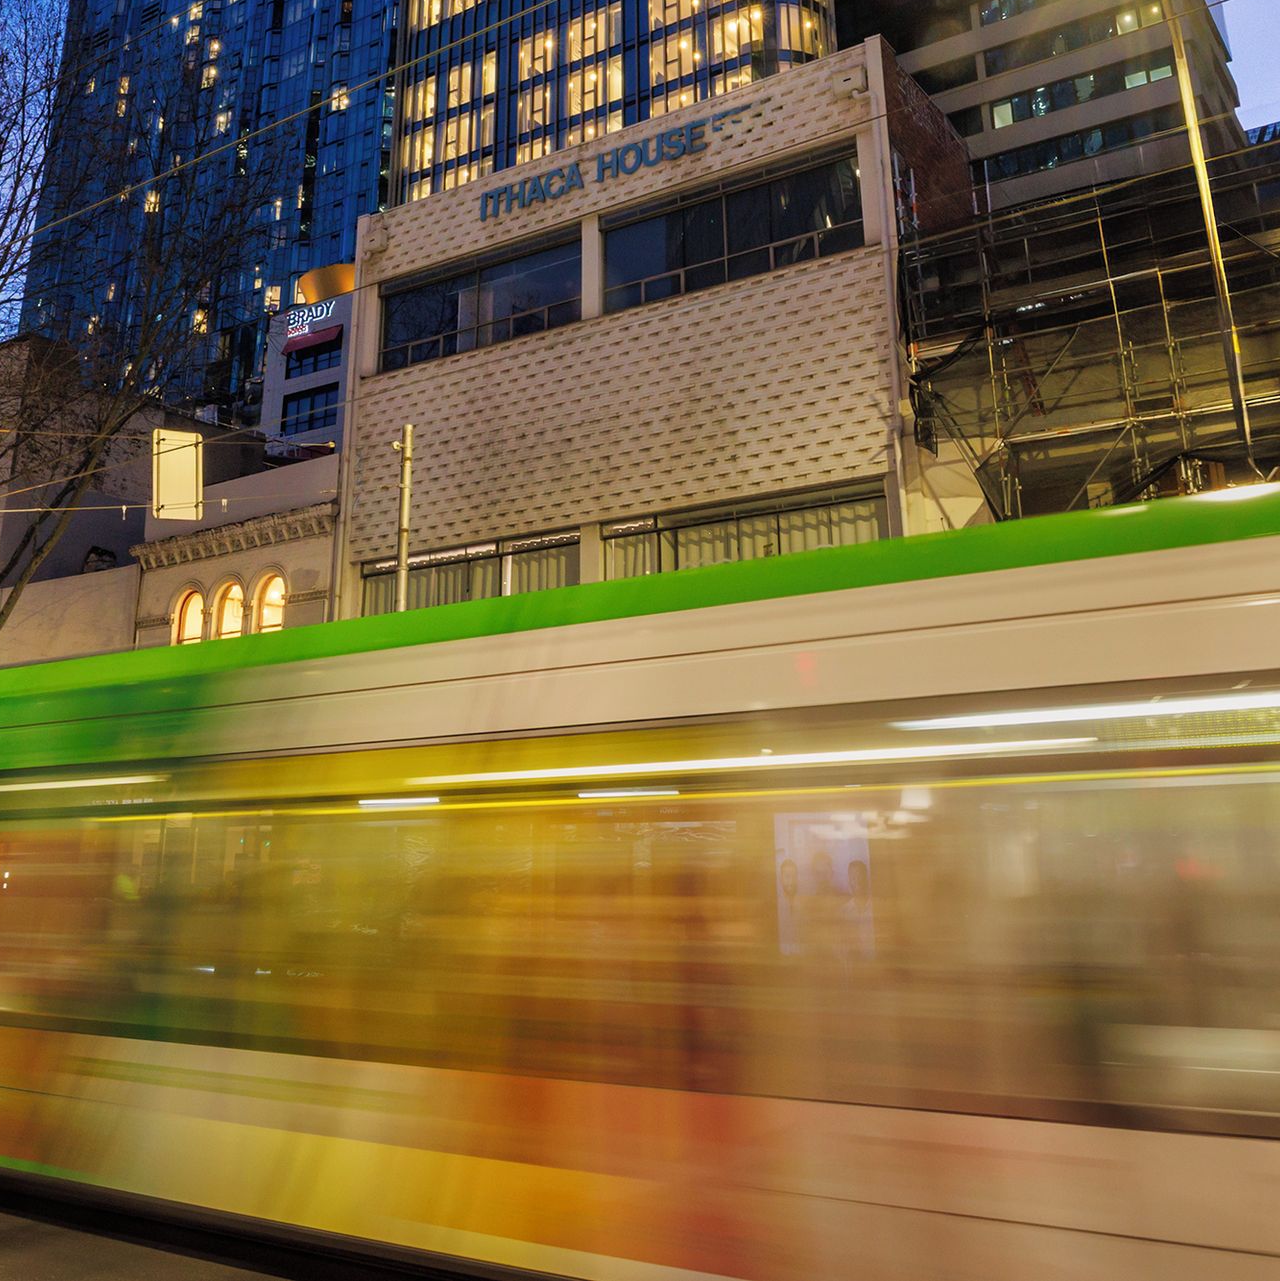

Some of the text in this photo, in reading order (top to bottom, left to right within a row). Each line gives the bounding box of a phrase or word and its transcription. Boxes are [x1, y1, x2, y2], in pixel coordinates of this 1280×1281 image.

[480, 120, 708, 222] ITHACA HOUSE
[287, 300, 336, 328] BRADY
